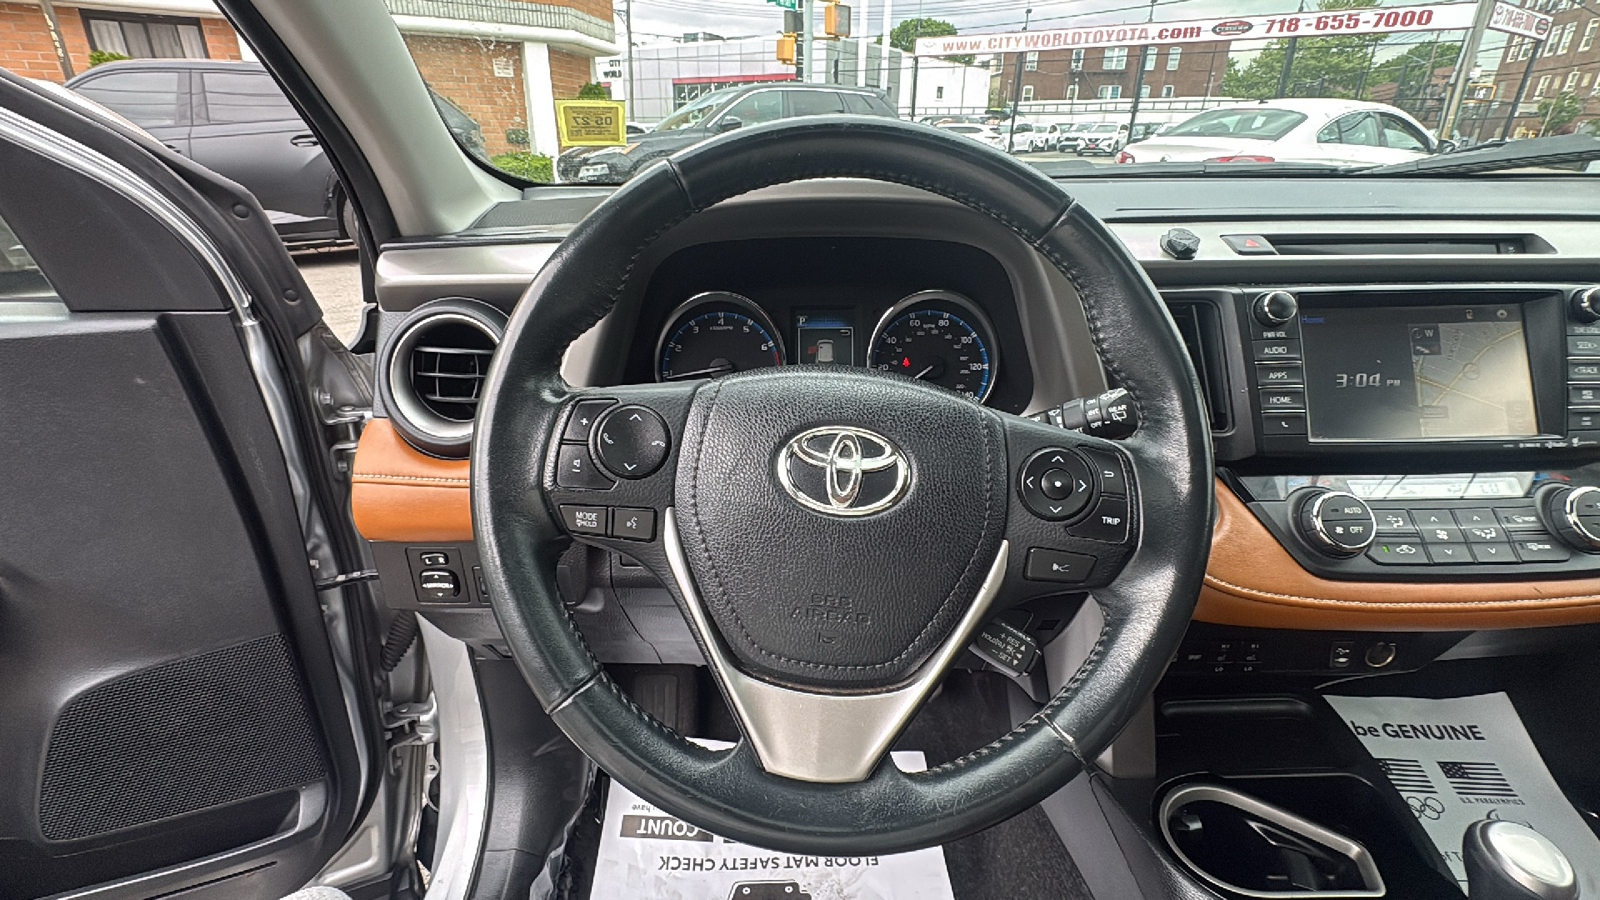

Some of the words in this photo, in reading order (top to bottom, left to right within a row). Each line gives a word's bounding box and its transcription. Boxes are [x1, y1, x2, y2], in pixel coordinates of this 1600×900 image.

[603, 69, 622, 78] WORLD
[909, 319, 921, 327] 60
[938, 319, 950, 327] 80
[693, 326, 699, 334] 3
[1424, 329, 1434, 338] W
[885, 336, 897, 344] 40
[960, 336, 973, 344] 100
[675, 344, 682, 352] 2
[761, 343, 768, 351] 6
[1264, 346, 1288, 355] AUDIO
[969, 363, 982, 371] 120
[1268, 371, 1288, 379] APPS
[1336, 373, 1381, 388] 3:04
[1269, 396, 1293, 404] HOME
[1107, 404, 1128, 413] REAR
[1090, 420, 1103, 429] OFF
[1344, 507, 1362, 515] AUTO
[575, 511, 598, 521] MODE
[1101, 517, 1121, 526] TRIP
[1349, 526, 1364, 534] OFF
[1350, 719, 1381, 738] be
[1381, 722, 1486, 741] GENUINE
[631, 804, 651, 813] have
[636, 818, 699, 838] COUNT
[658, 856, 716, 872] CHECK
[719, 856, 780, 871] SAFETY
[783, 856, 819, 869] MAT
